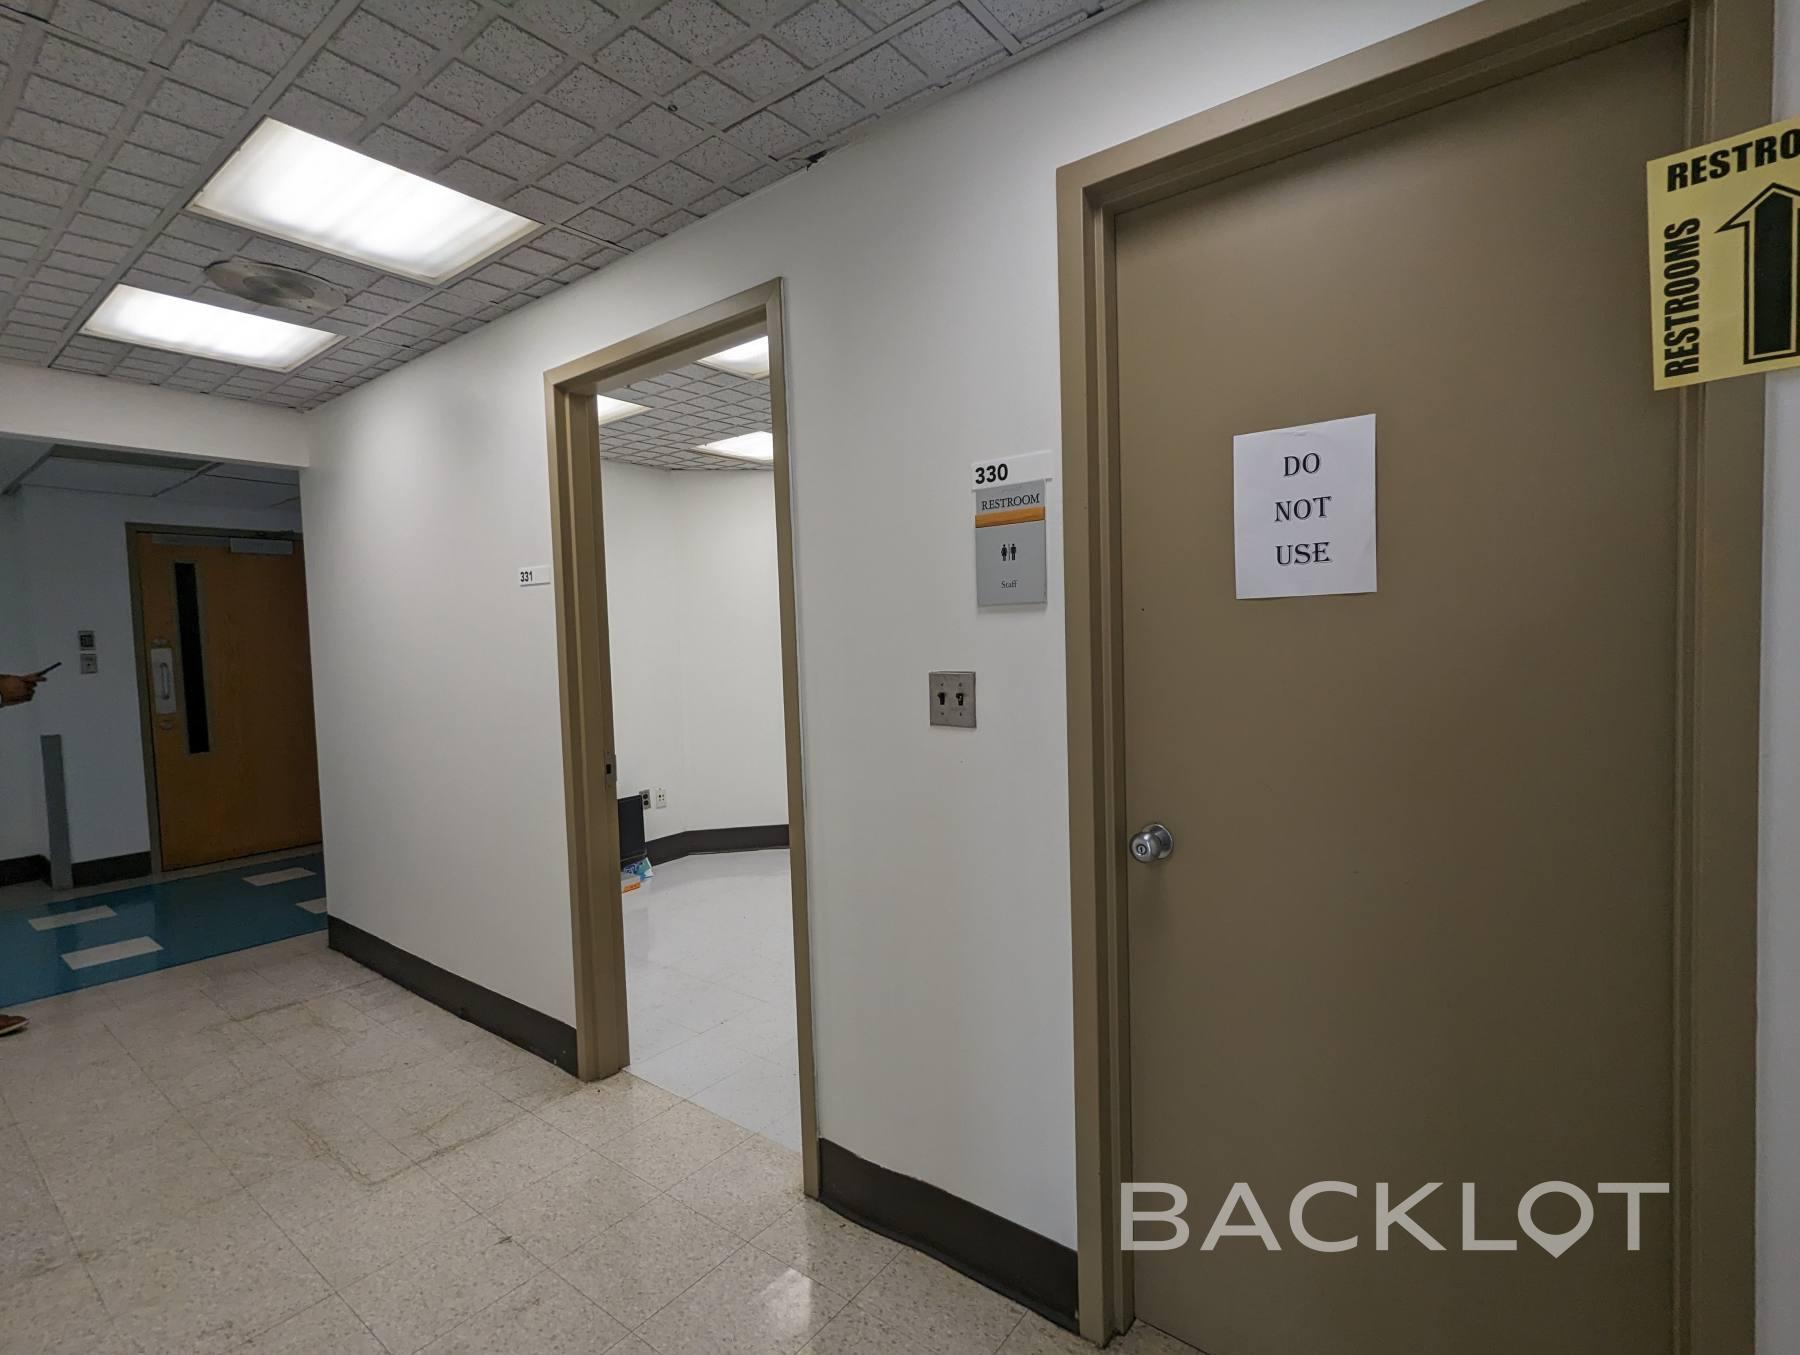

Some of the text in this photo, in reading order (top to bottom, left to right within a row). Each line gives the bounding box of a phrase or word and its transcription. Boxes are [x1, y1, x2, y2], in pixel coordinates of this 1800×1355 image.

[1664, 217, 1701, 378] RESTROOMS
[975, 464, 1008, 484] 330
[1284, 453, 1320, 477] DO
[981, 493, 1040, 511] RESTROOM
[1274, 496, 1332, 522] NOT
[1275, 542, 1331, 566] USE
[520, 570, 533, 582] 331
[1001, 580, 1018, 589] Staff
